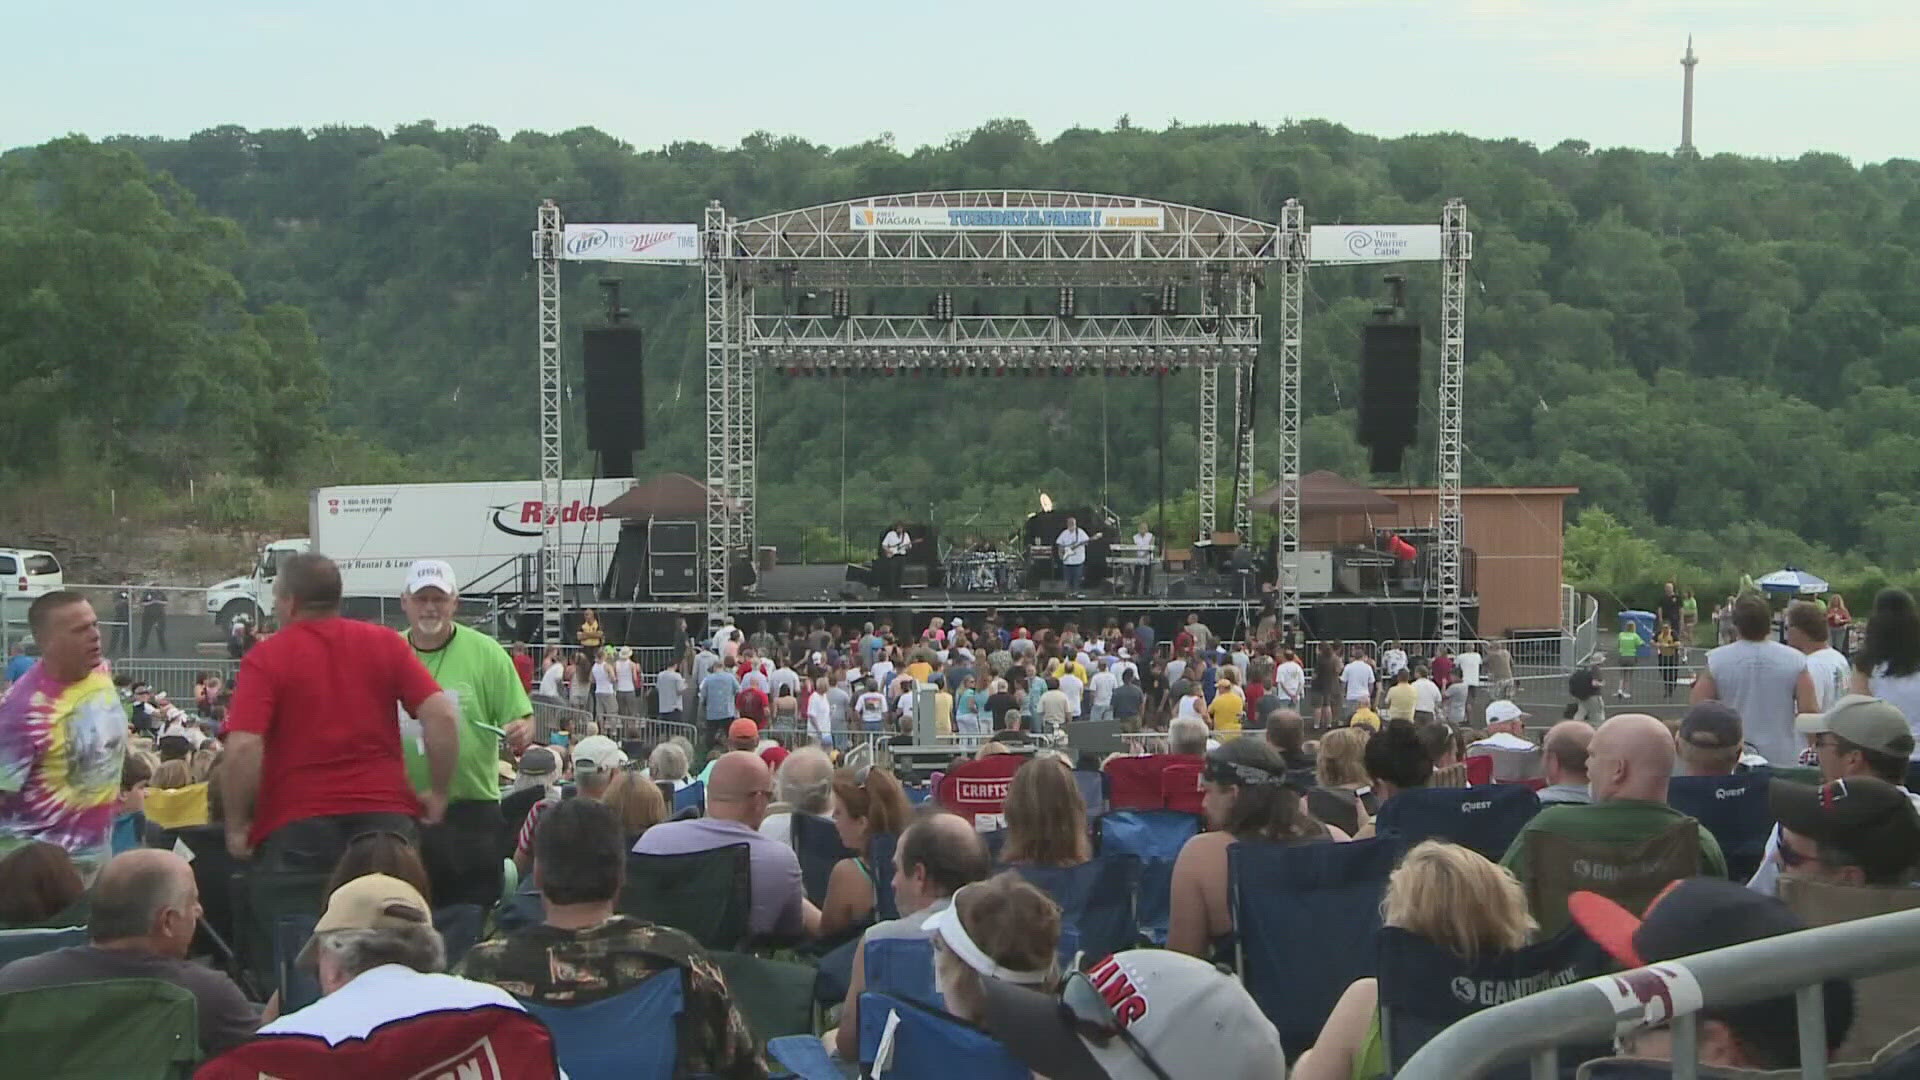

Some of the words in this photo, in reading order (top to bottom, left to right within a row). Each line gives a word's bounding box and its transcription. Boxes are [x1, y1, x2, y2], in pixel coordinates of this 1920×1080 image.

[876, 217, 921, 225] NIAGARA
[948, 210, 1026, 226] TUESDAY
[1375, 231, 1398, 239] Time
[628, 231, 677, 252] Miller
[677, 236, 695, 248] TIME
[1374, 248, 1401, 256] Cable
[521, 500, 604, 525] Ryder
[355, 560, 382, 569] Rental
[385, 560, 392, 568] &
[394, 560, 414, 568] Lea
[962, 783, 1008, 798] CRAFTS
[1715, 787, 1746, 800] QUEST
[1461, 801, 1492, 812] QUEST
